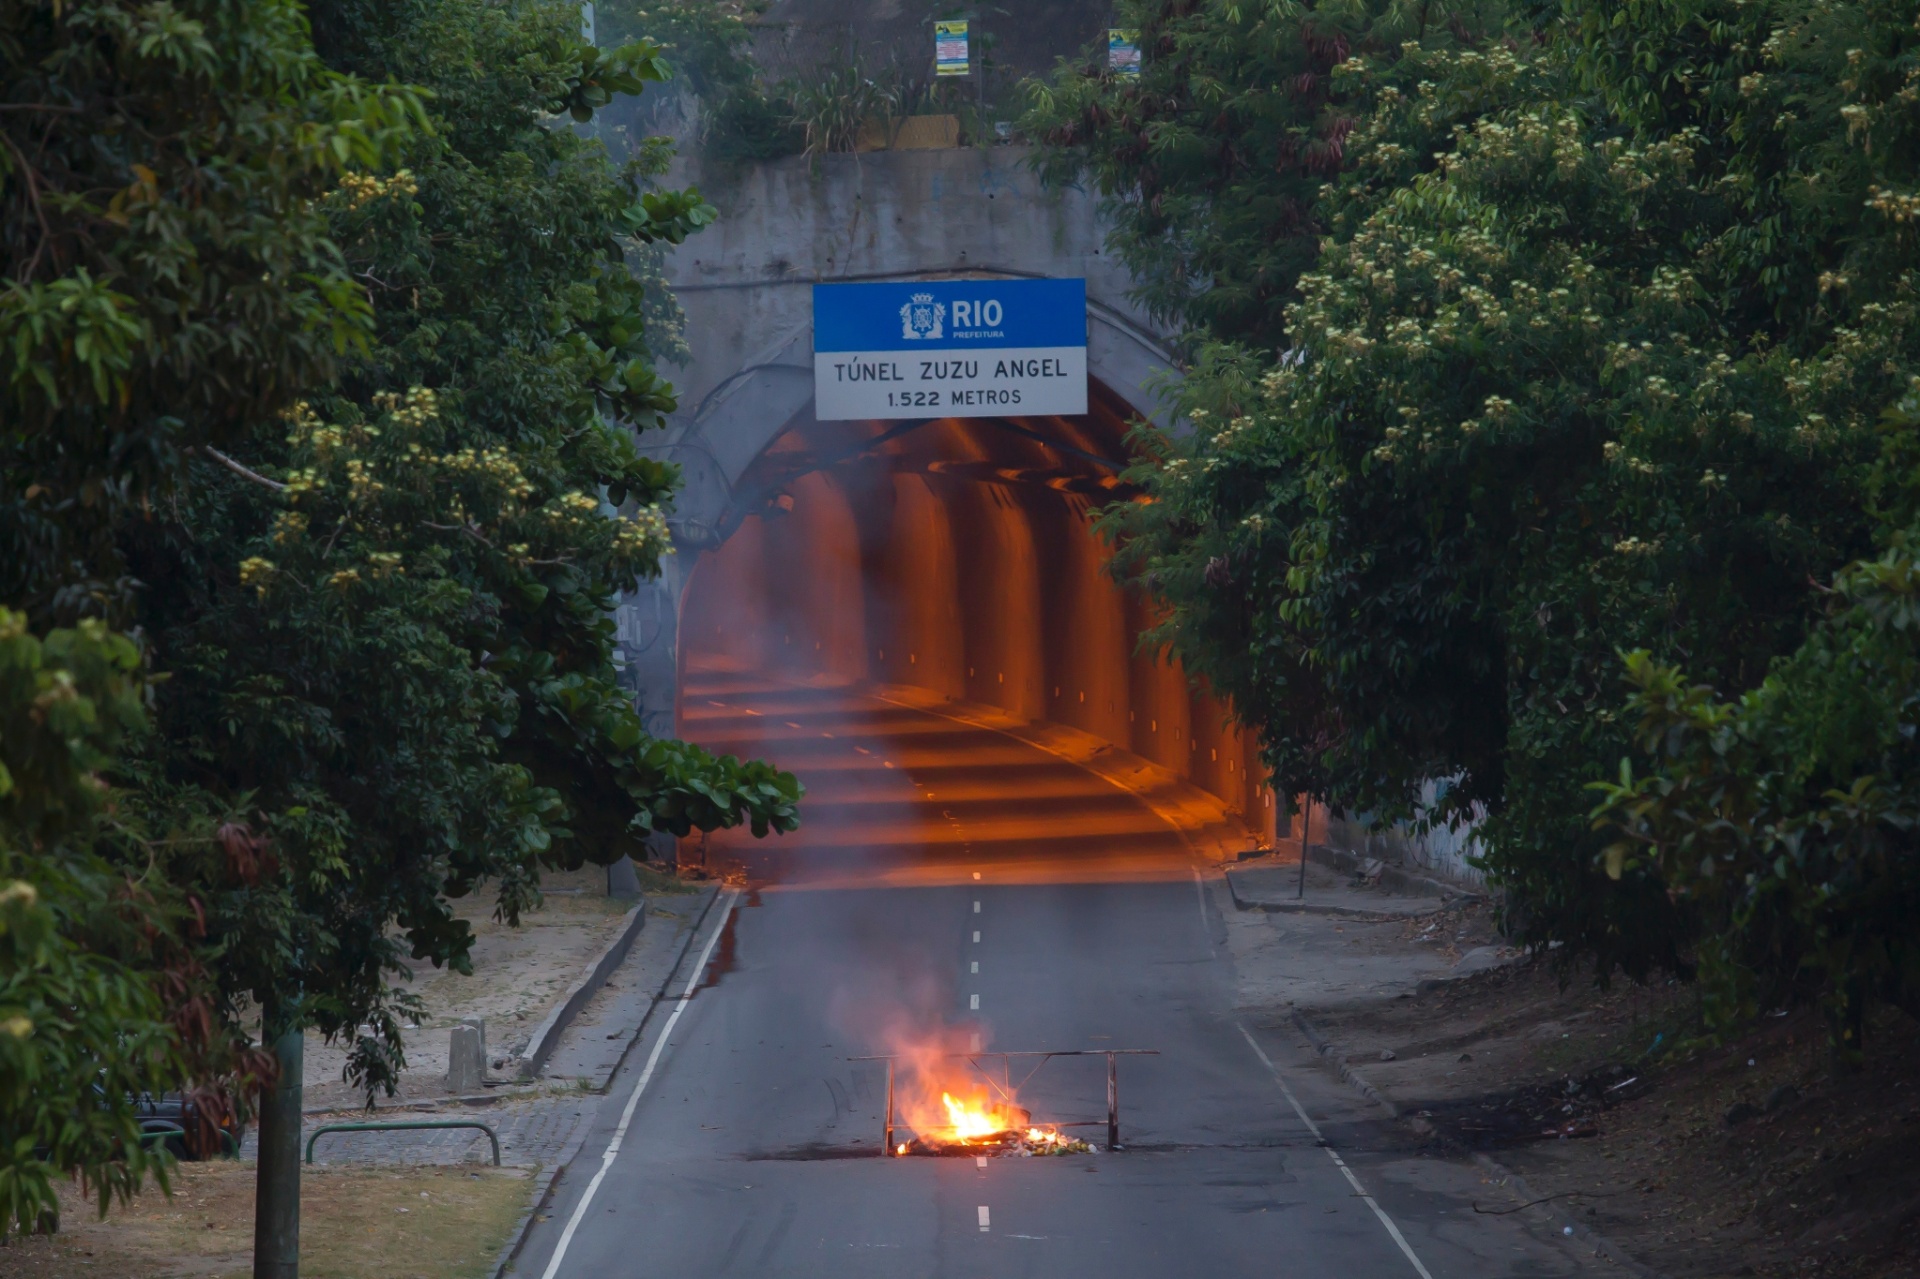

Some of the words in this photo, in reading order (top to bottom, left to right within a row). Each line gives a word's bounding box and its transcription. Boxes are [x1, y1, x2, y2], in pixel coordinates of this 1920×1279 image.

[952, 300, 1003, 327] RIO
[953, 331, 1005, 339] PREFEITURA
[834, 356, 904, 381] TÚNEL
[920, 361, 979, 380] ZUZU
[994, 359, 1068, 378] ANGEL
[888, 392, 940, 407] 1.522
[951, 389, 1022, 405] METROS
